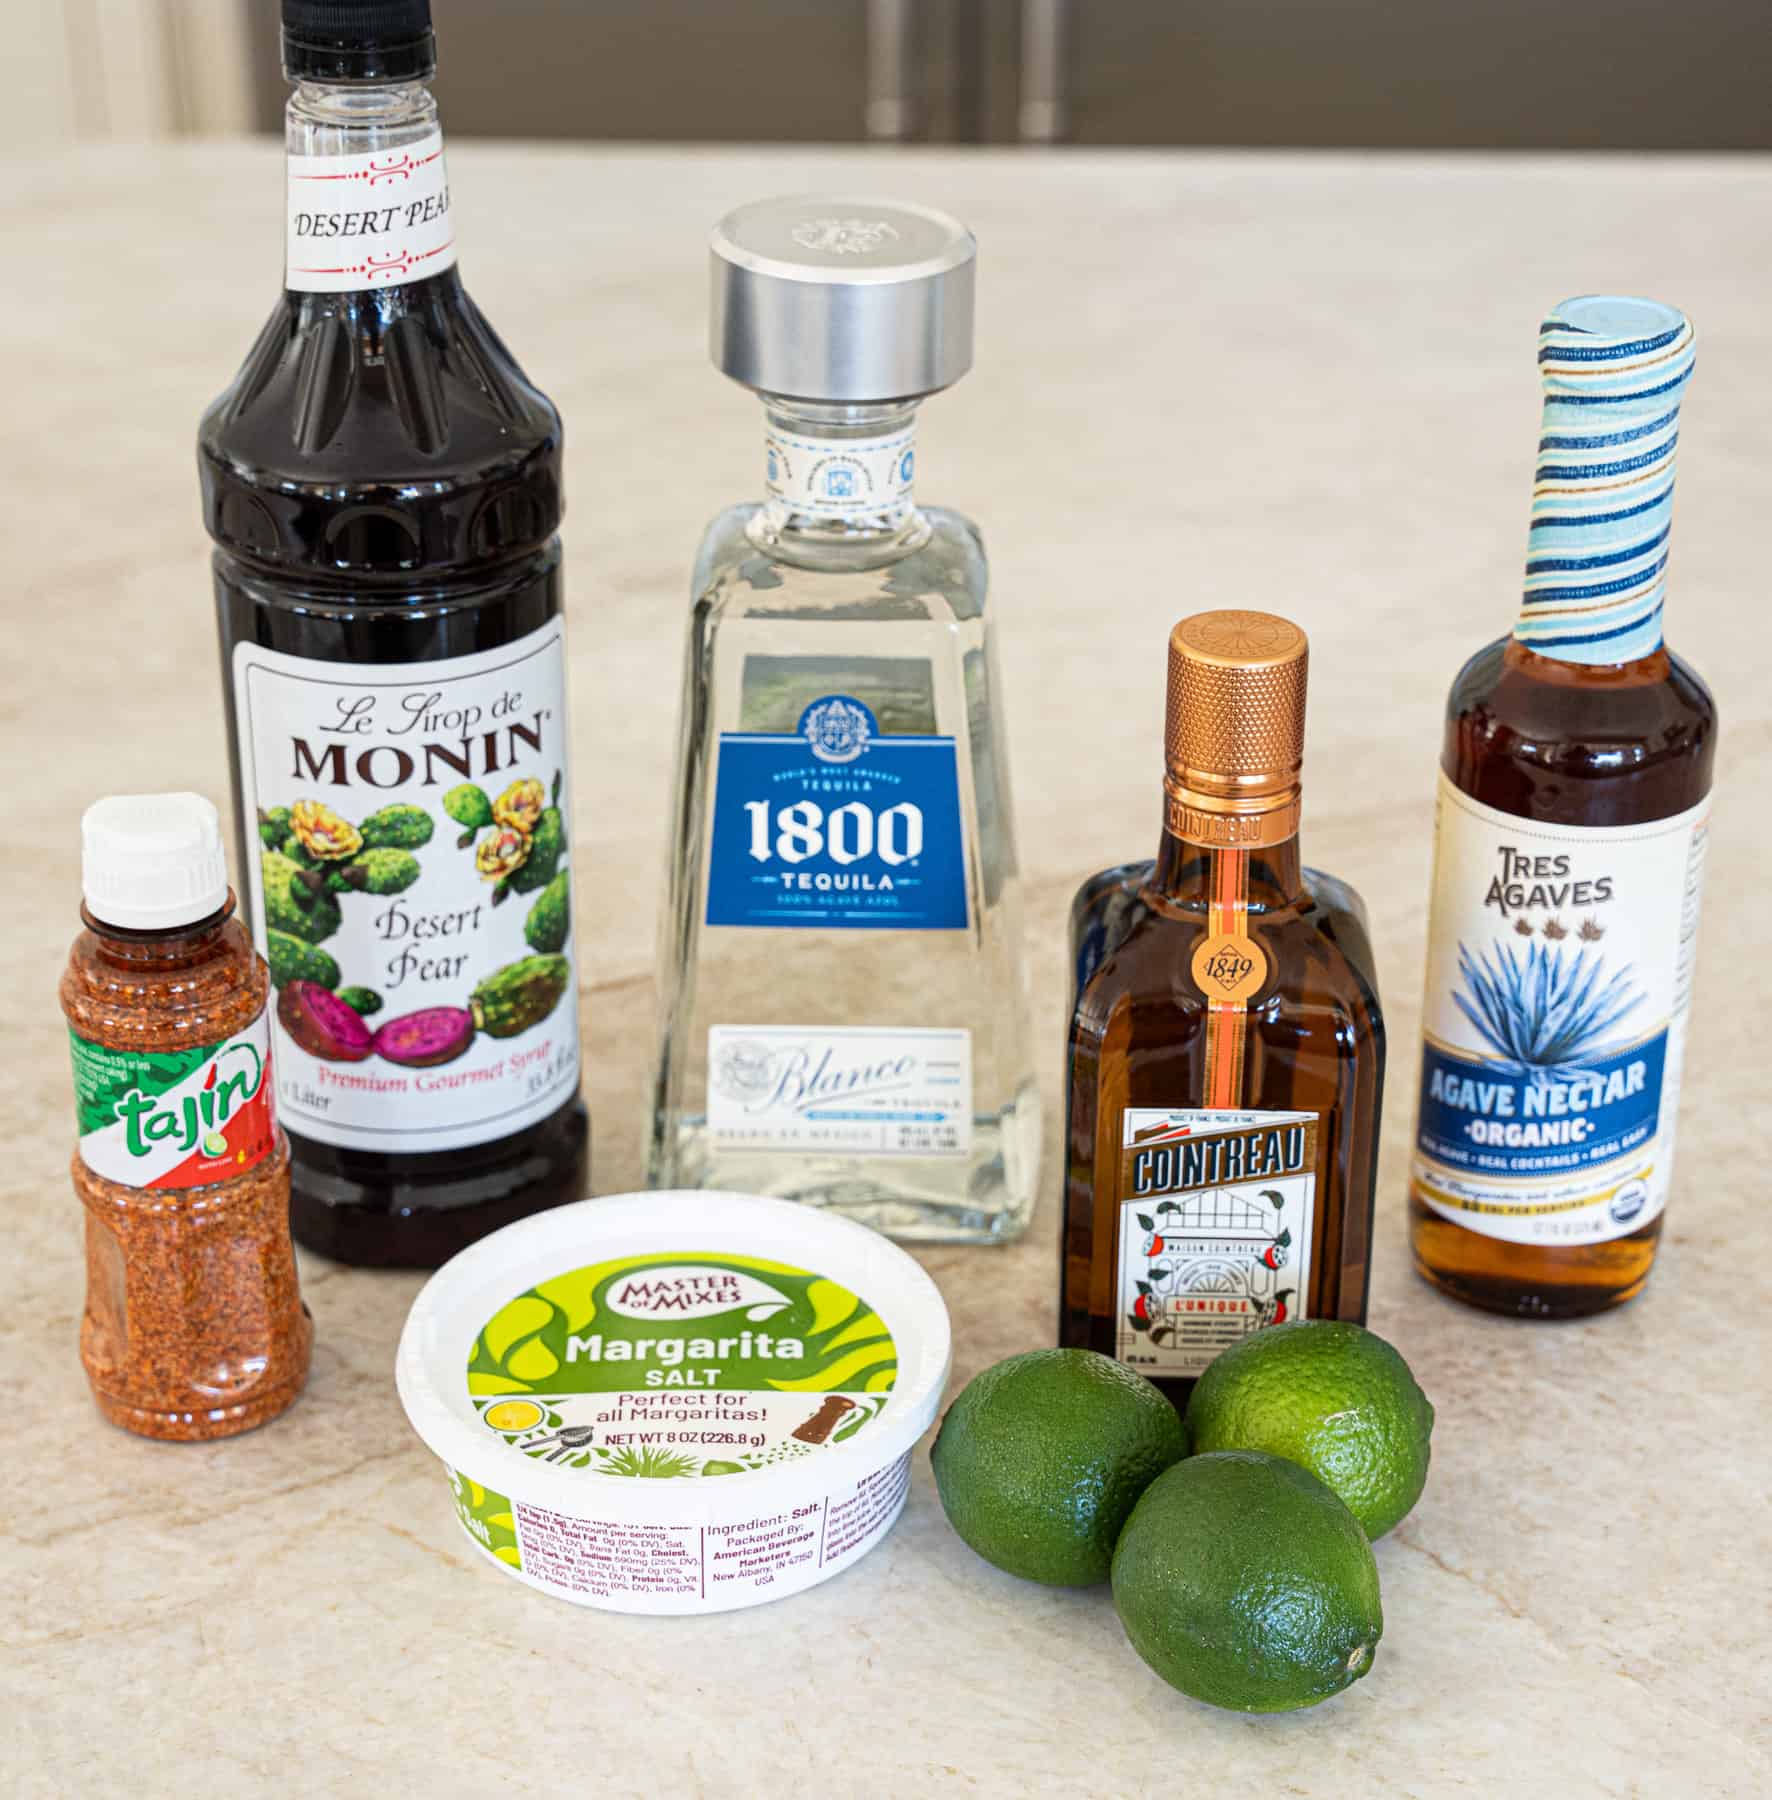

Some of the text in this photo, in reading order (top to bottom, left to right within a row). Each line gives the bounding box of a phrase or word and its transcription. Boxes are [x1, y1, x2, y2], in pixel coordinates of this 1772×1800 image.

[295, 205, 401, 238] DESERT
[319, 692, 523, 736] Le Sirop de
[291, 709, 549, 788] MONIN
[802, 779, 872, 792] TEQUILA
[743, 799, 924, 866] 1800
[1498, 846, 1571, 885] TRES
[781, 872, 894, 891] TEQUILA
[1484, 875, 1614, 917] AGAVES
[375, 899, 482, 941] Desert
[385, 943, 469, 989] Pear
[1207, 957, 1253, 978] 1849
[319, 1066, 408, 1093] Premium
[415, 1061, 504, 1093] Gourmet
[745, 1048, 916, 1113] Blanco
[1430, 1060, 1647, 1117] AGAVE NECTAR
[1134, 1127, 1305, 1194] COINTREAU
[618, 1276, 738, 1304] MASTER
[650, 1290, 741, 1311] MIXES
[1175, 1300, 1248, 1312] L'UNIQUE
[565, 1331, 805, 1365] Margarita
[645, 1369, 721, 1387] SALT
[618, 1393, 748, 1407] Perfect for
[596, 1408, 768, 1422] all Margaritas!
[605, 1432, 766, 1447] NET WT 8 OZ (226.8 g)
[571, 1523, 608, 1535] Amount
[708, 1515, 788, 1536] Ingredient:
[792, 1503, 822, 1519] Salt.
[583, 1534, 598, 1542] Fat
[713, 1531, 814, 1560] American Beverage
[727, 1524, 804, 1547] Packaged By:
[580, 1551, 612, 1561] Sodium
[615, 1547, 630, 1555] Fat
[651, 1549, 689, 1557] Cholest.
[739, 1550, 791, 1568] Marketers
[621, 1565, 645, 1573] Fiber
[631, 1575, 665, 1583] Protein
[713, 1573, 735, 1581] New
[776, 1560, 785, 1569] IN
[755, 1575, 775, 1586] USA
